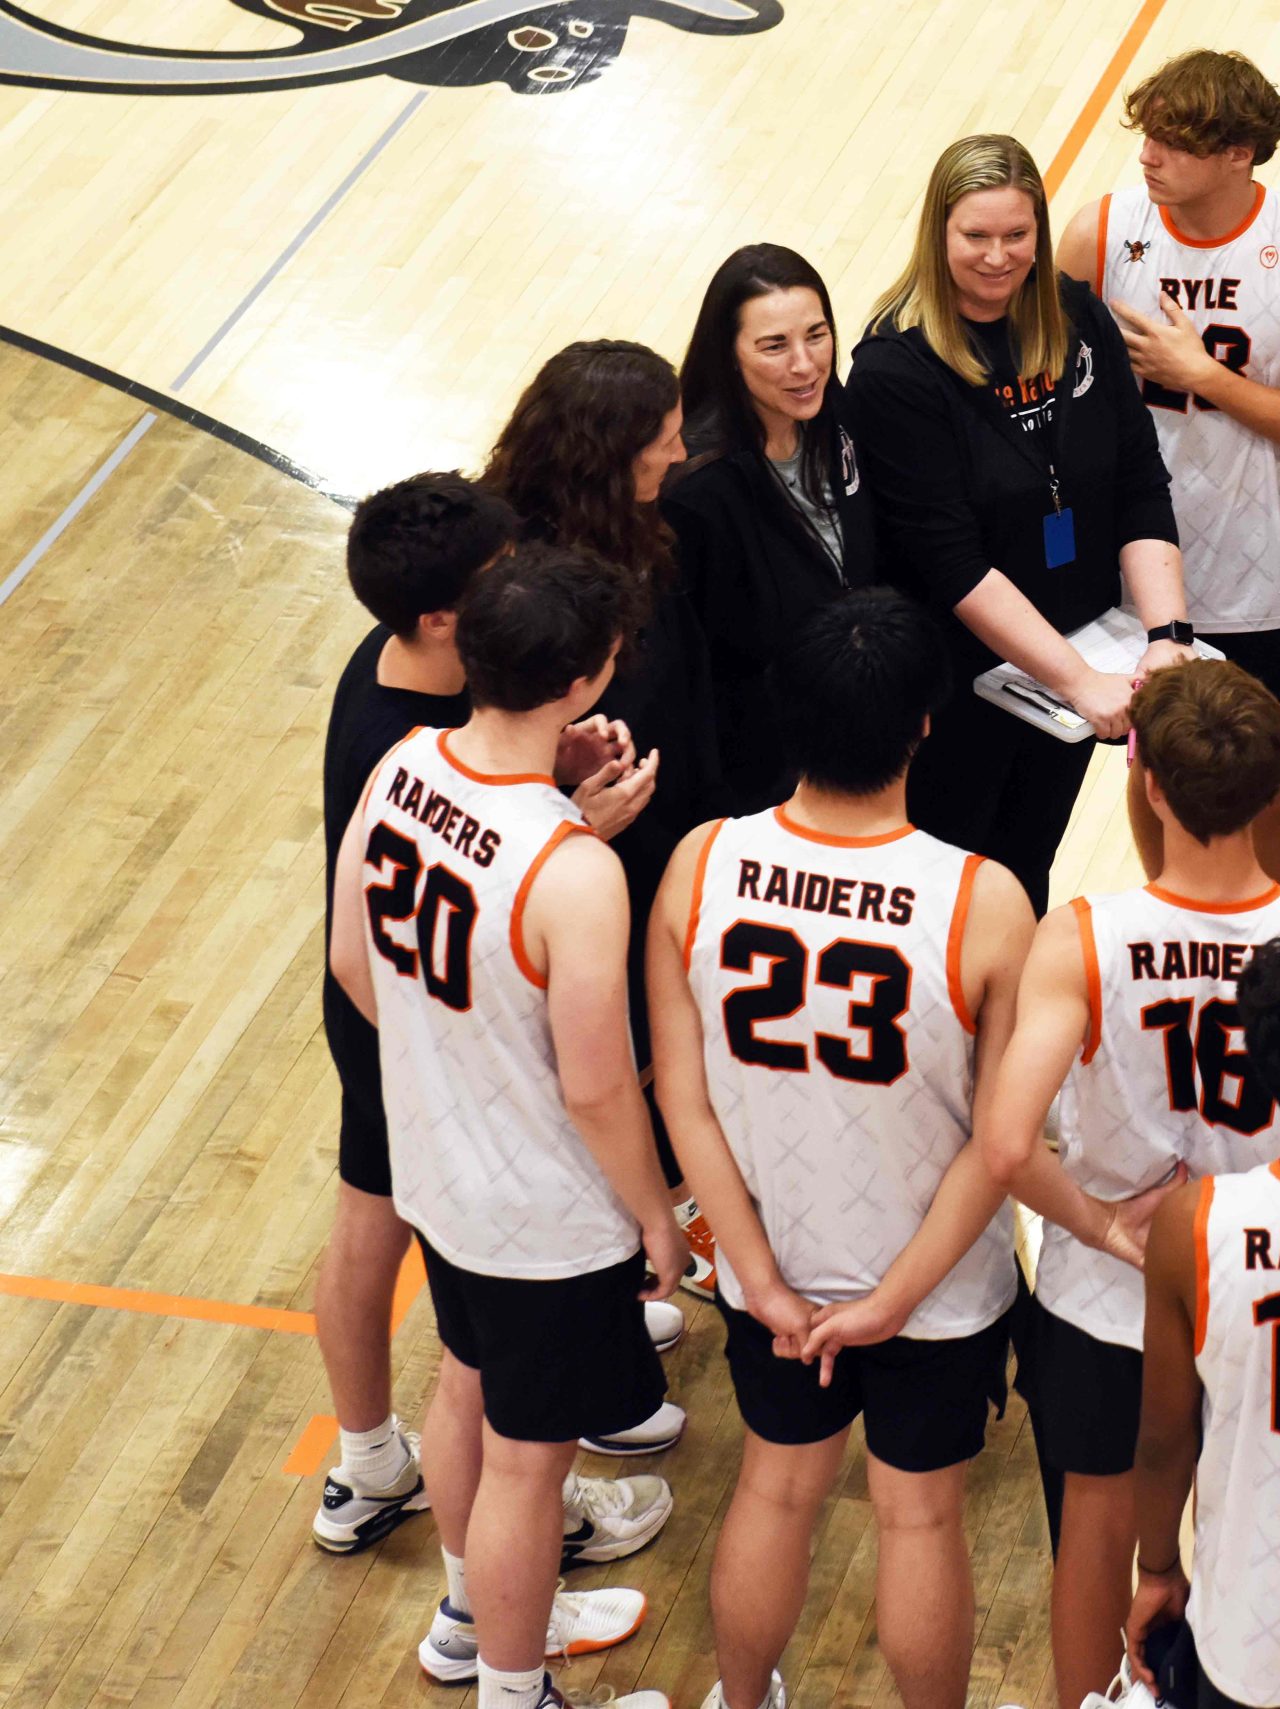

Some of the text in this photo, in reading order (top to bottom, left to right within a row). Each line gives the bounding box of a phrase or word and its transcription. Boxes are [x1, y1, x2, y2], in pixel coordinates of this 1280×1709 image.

[1159, 278, 1241, 310] RYLE
[387, 767, 501, 868] RAIDERS
[364, 820, 479, 1012] 20
[738, 859, 915, 926] RAIDERS
[721, 918, 912, 1086] 23
[1127, 941, 1259, 981] RAIDE
[1140, 997, 1276, 1136] 16
